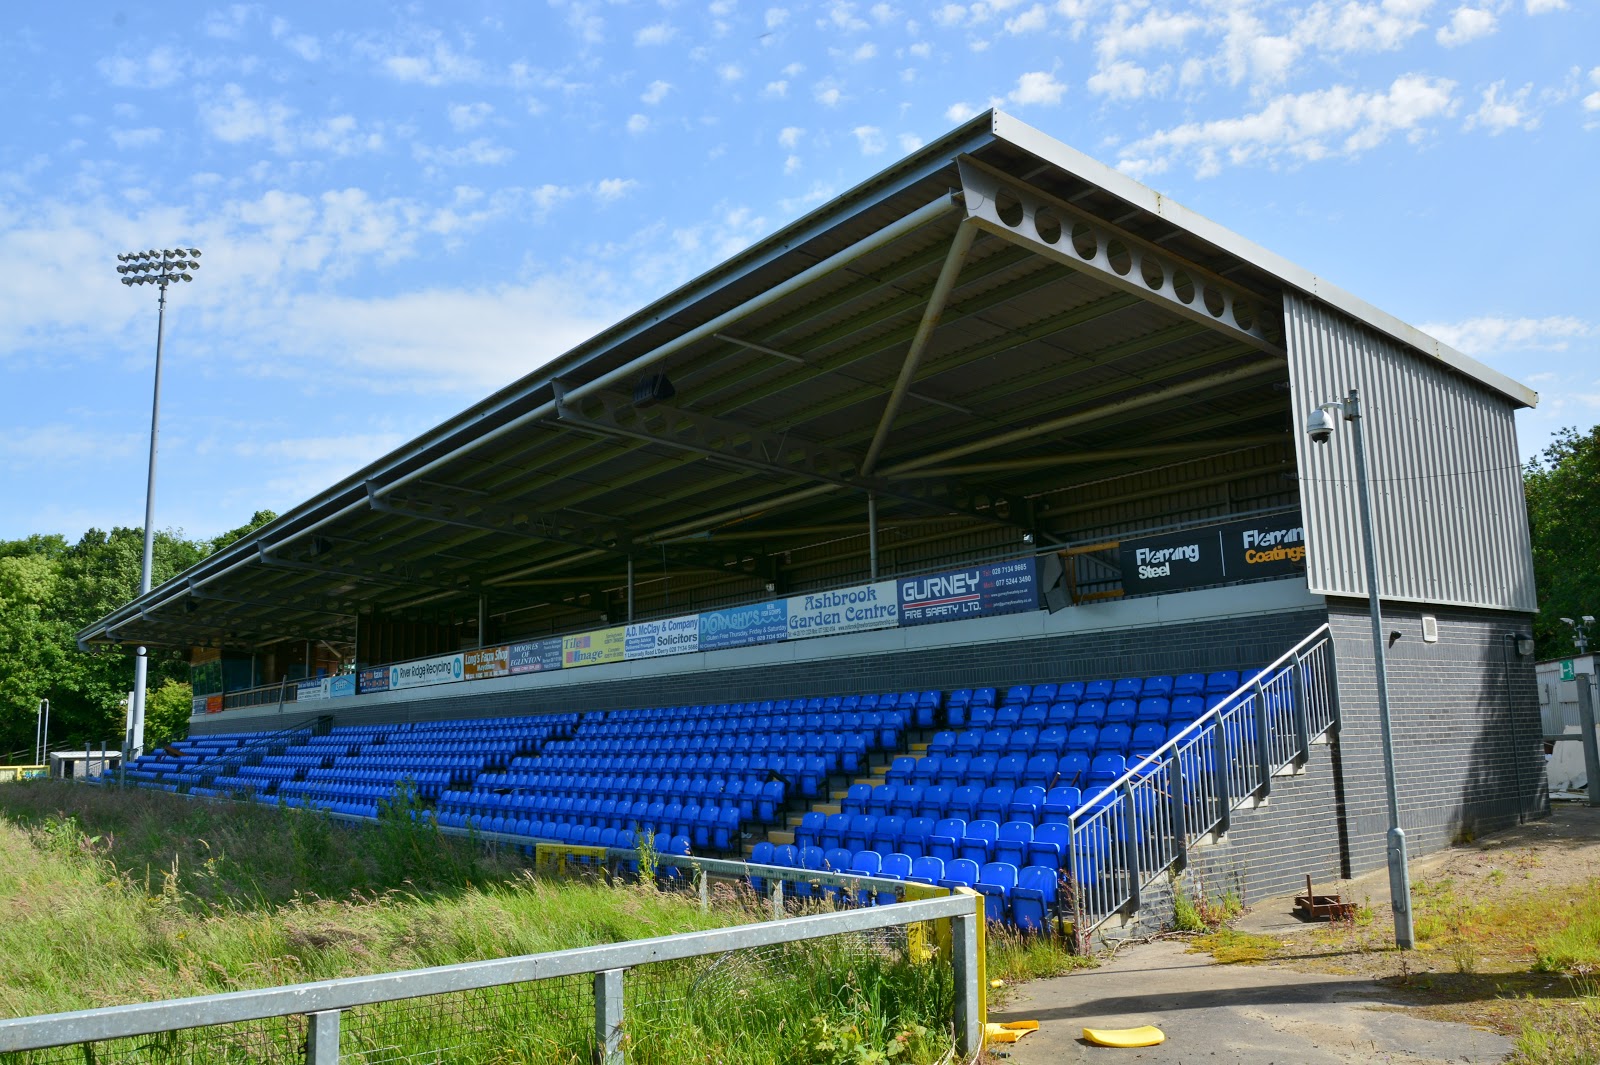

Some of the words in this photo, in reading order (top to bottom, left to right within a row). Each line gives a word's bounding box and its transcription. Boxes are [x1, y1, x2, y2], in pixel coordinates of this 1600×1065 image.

[1243, 527, 1304, 549] Flemin
[1136, 544, 1200, 566] Fleming
[992, 567, 1001, 575] 028
[1001, 565, 1014, 574] 7134
[1138, 562, 1170, 579] Steel
[903, 571, 979, 601] GURNEY
[996, 578, 1005, 587] 077
[805, 586, 877, 611] Ashbrook
[789, 612, 841, 629] Garden
[845, 604, 897, 621] Centre
[905, 609, 922, 619] FIRE
[926, 604, 959, 617] SAFETY
[962, 601, 981, 613] LTD.
[625, 626, 637, 637] A.D.
[638, 624, 660, 635] McClay
[661, 621, 666, 632] &
[668, 618, 698, 631] Company
[700, 610, 760, 634] DONAGHY'S
[749, 627, 762, 635] Friday
[767, 625, 786, 633] Saturday
[513, 643, 539, 653] MOORES
[564, 637, 582, 649] Tile
[657, 633, 697, 646] Solicitors
[465, 652, 480, 666] Long's
[481, 651, 494, 662] Farm
[495, 649, 508, 661] Shop
[511, 656, 541, 666] EGLINTON
[574, 649, 603, 662] Image
[400, 667, 410, 678] River
[412, 664, 426, 678] Ridge
[426, 660, 451, 676] Recycling
